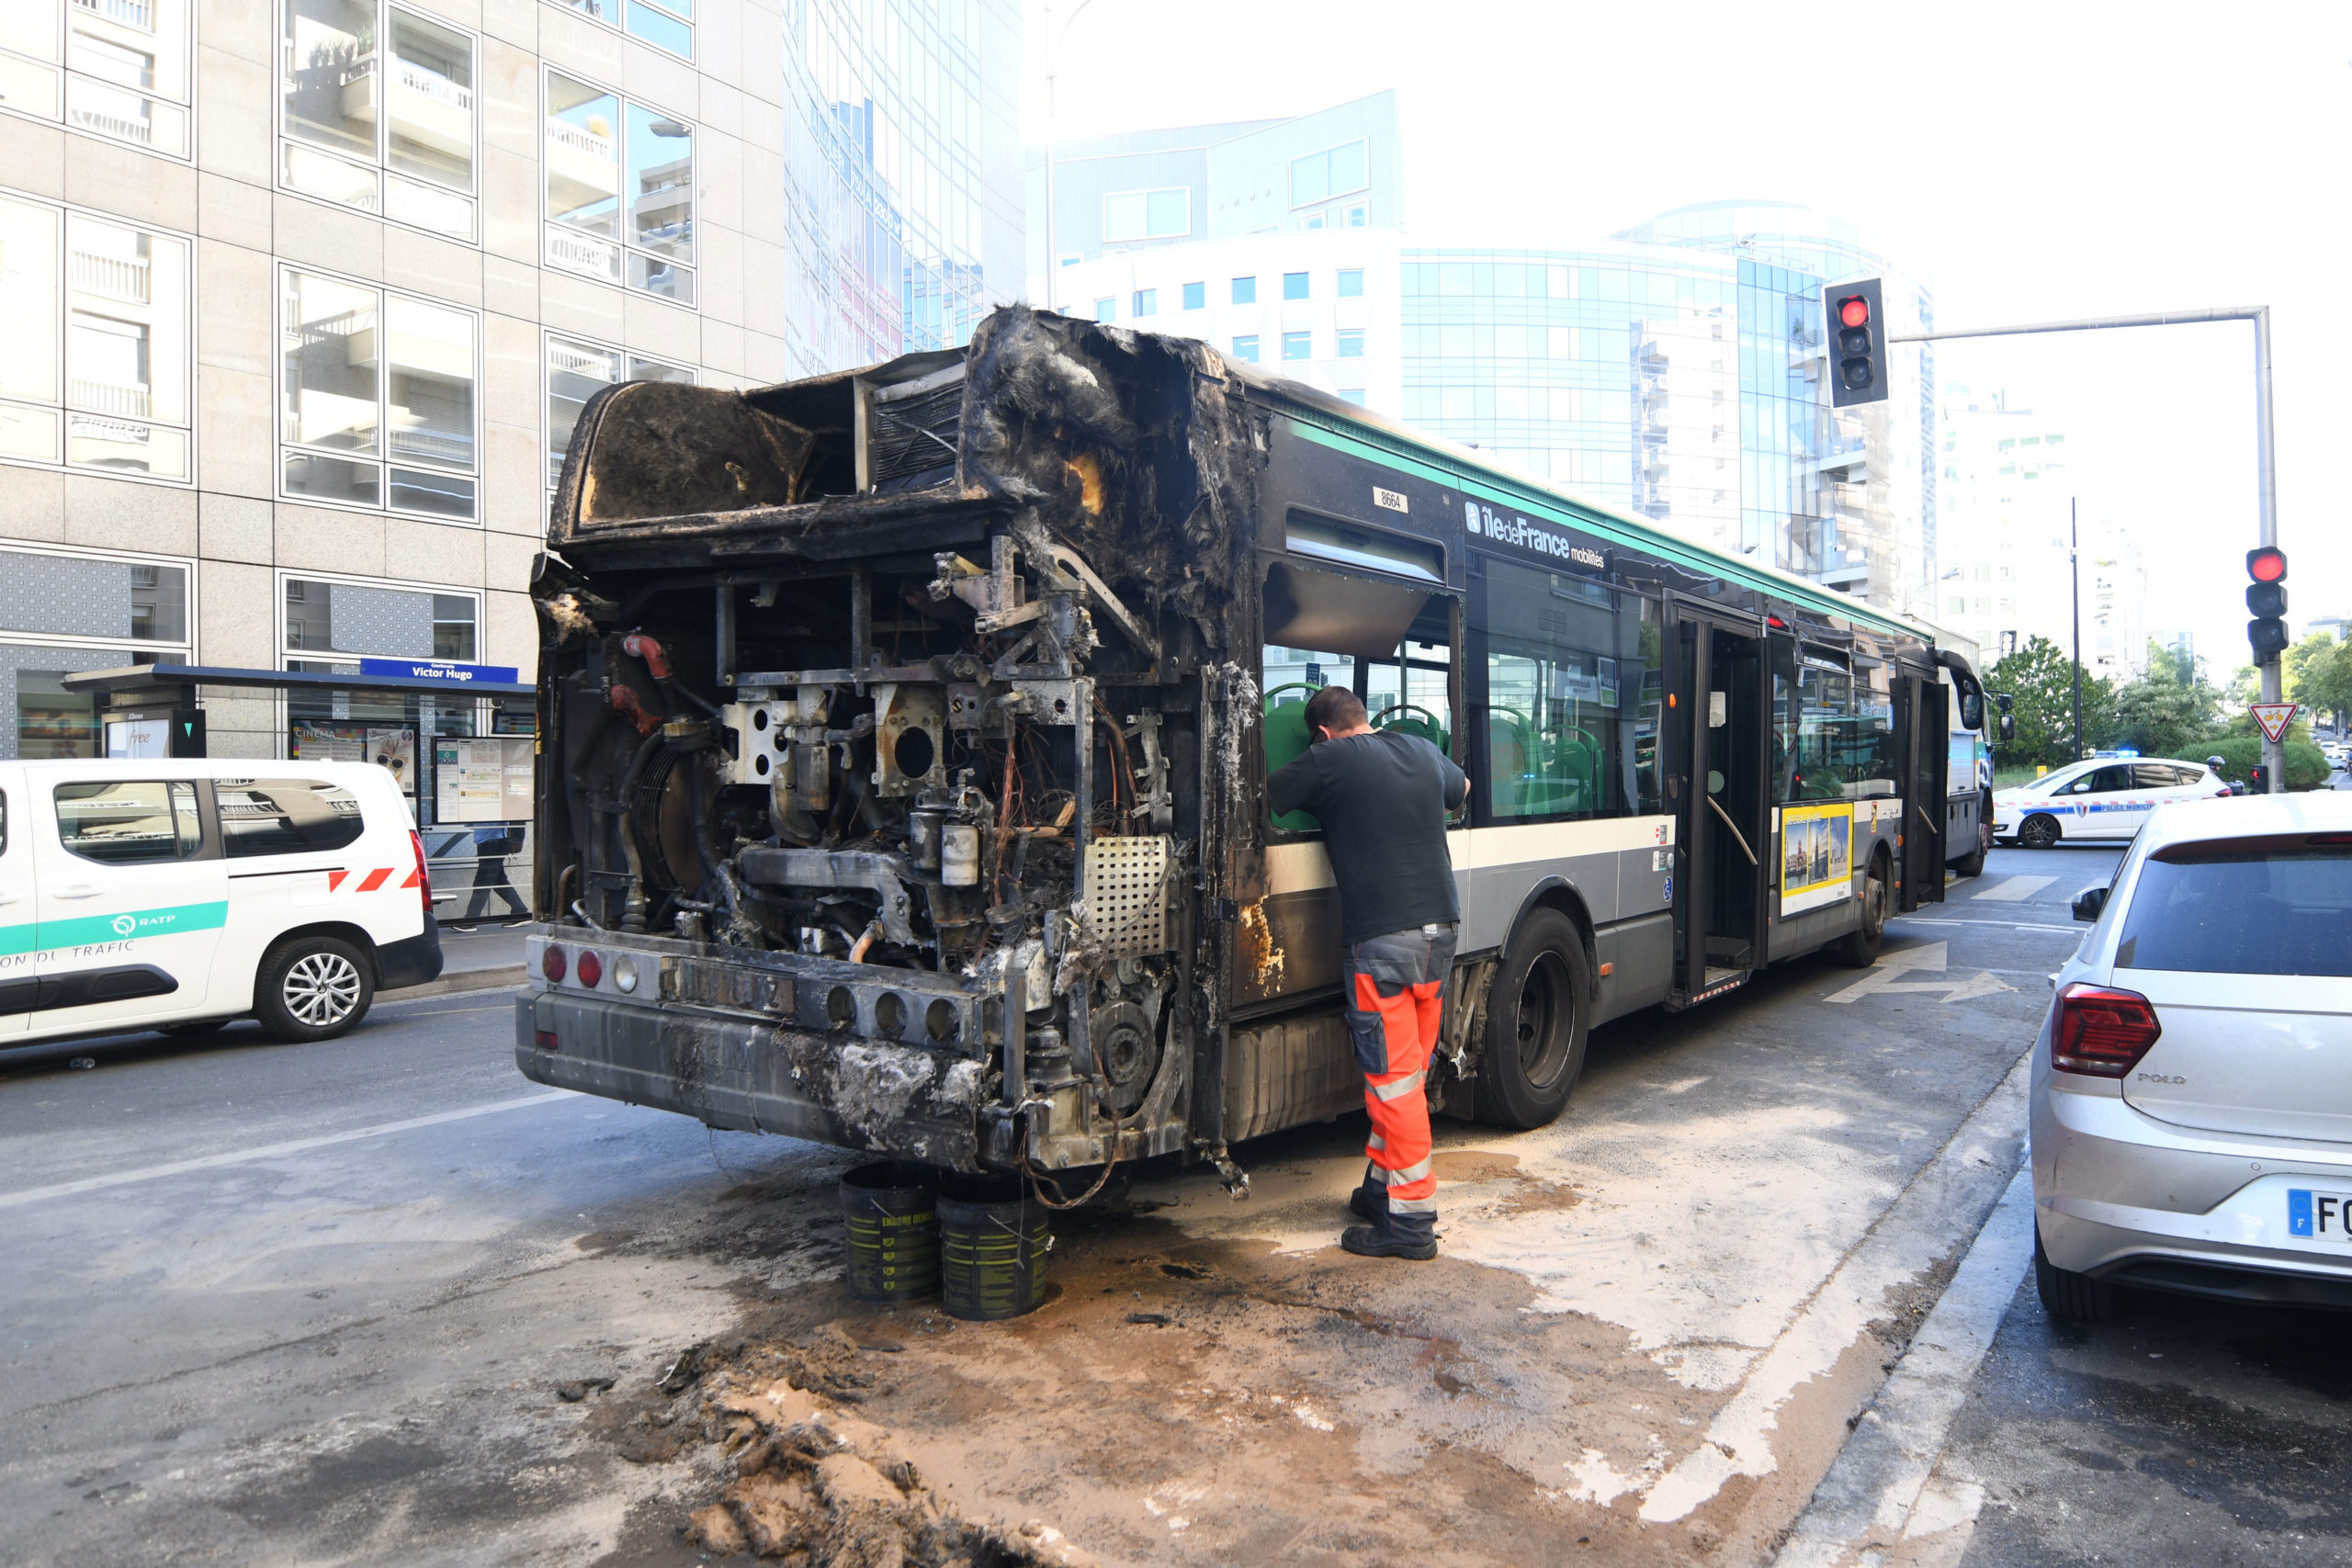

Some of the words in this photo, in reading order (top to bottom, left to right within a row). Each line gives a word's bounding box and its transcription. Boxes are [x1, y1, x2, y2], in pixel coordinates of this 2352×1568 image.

[1381, 491, 1401, 509] 8664
[1570, 547, 1604, 569] mobilités
[413, 667, 444, 678] Victor
[446, 669, 473, 682] Hugo
[129, 729, 151, 749] free
[139, 915, 176, 927] RATP
[73, 940, 134, 958] TRAFIC
[2138, 1073, 2187, 1085] POLO
[2297, 1218, 2305, 1229] F
